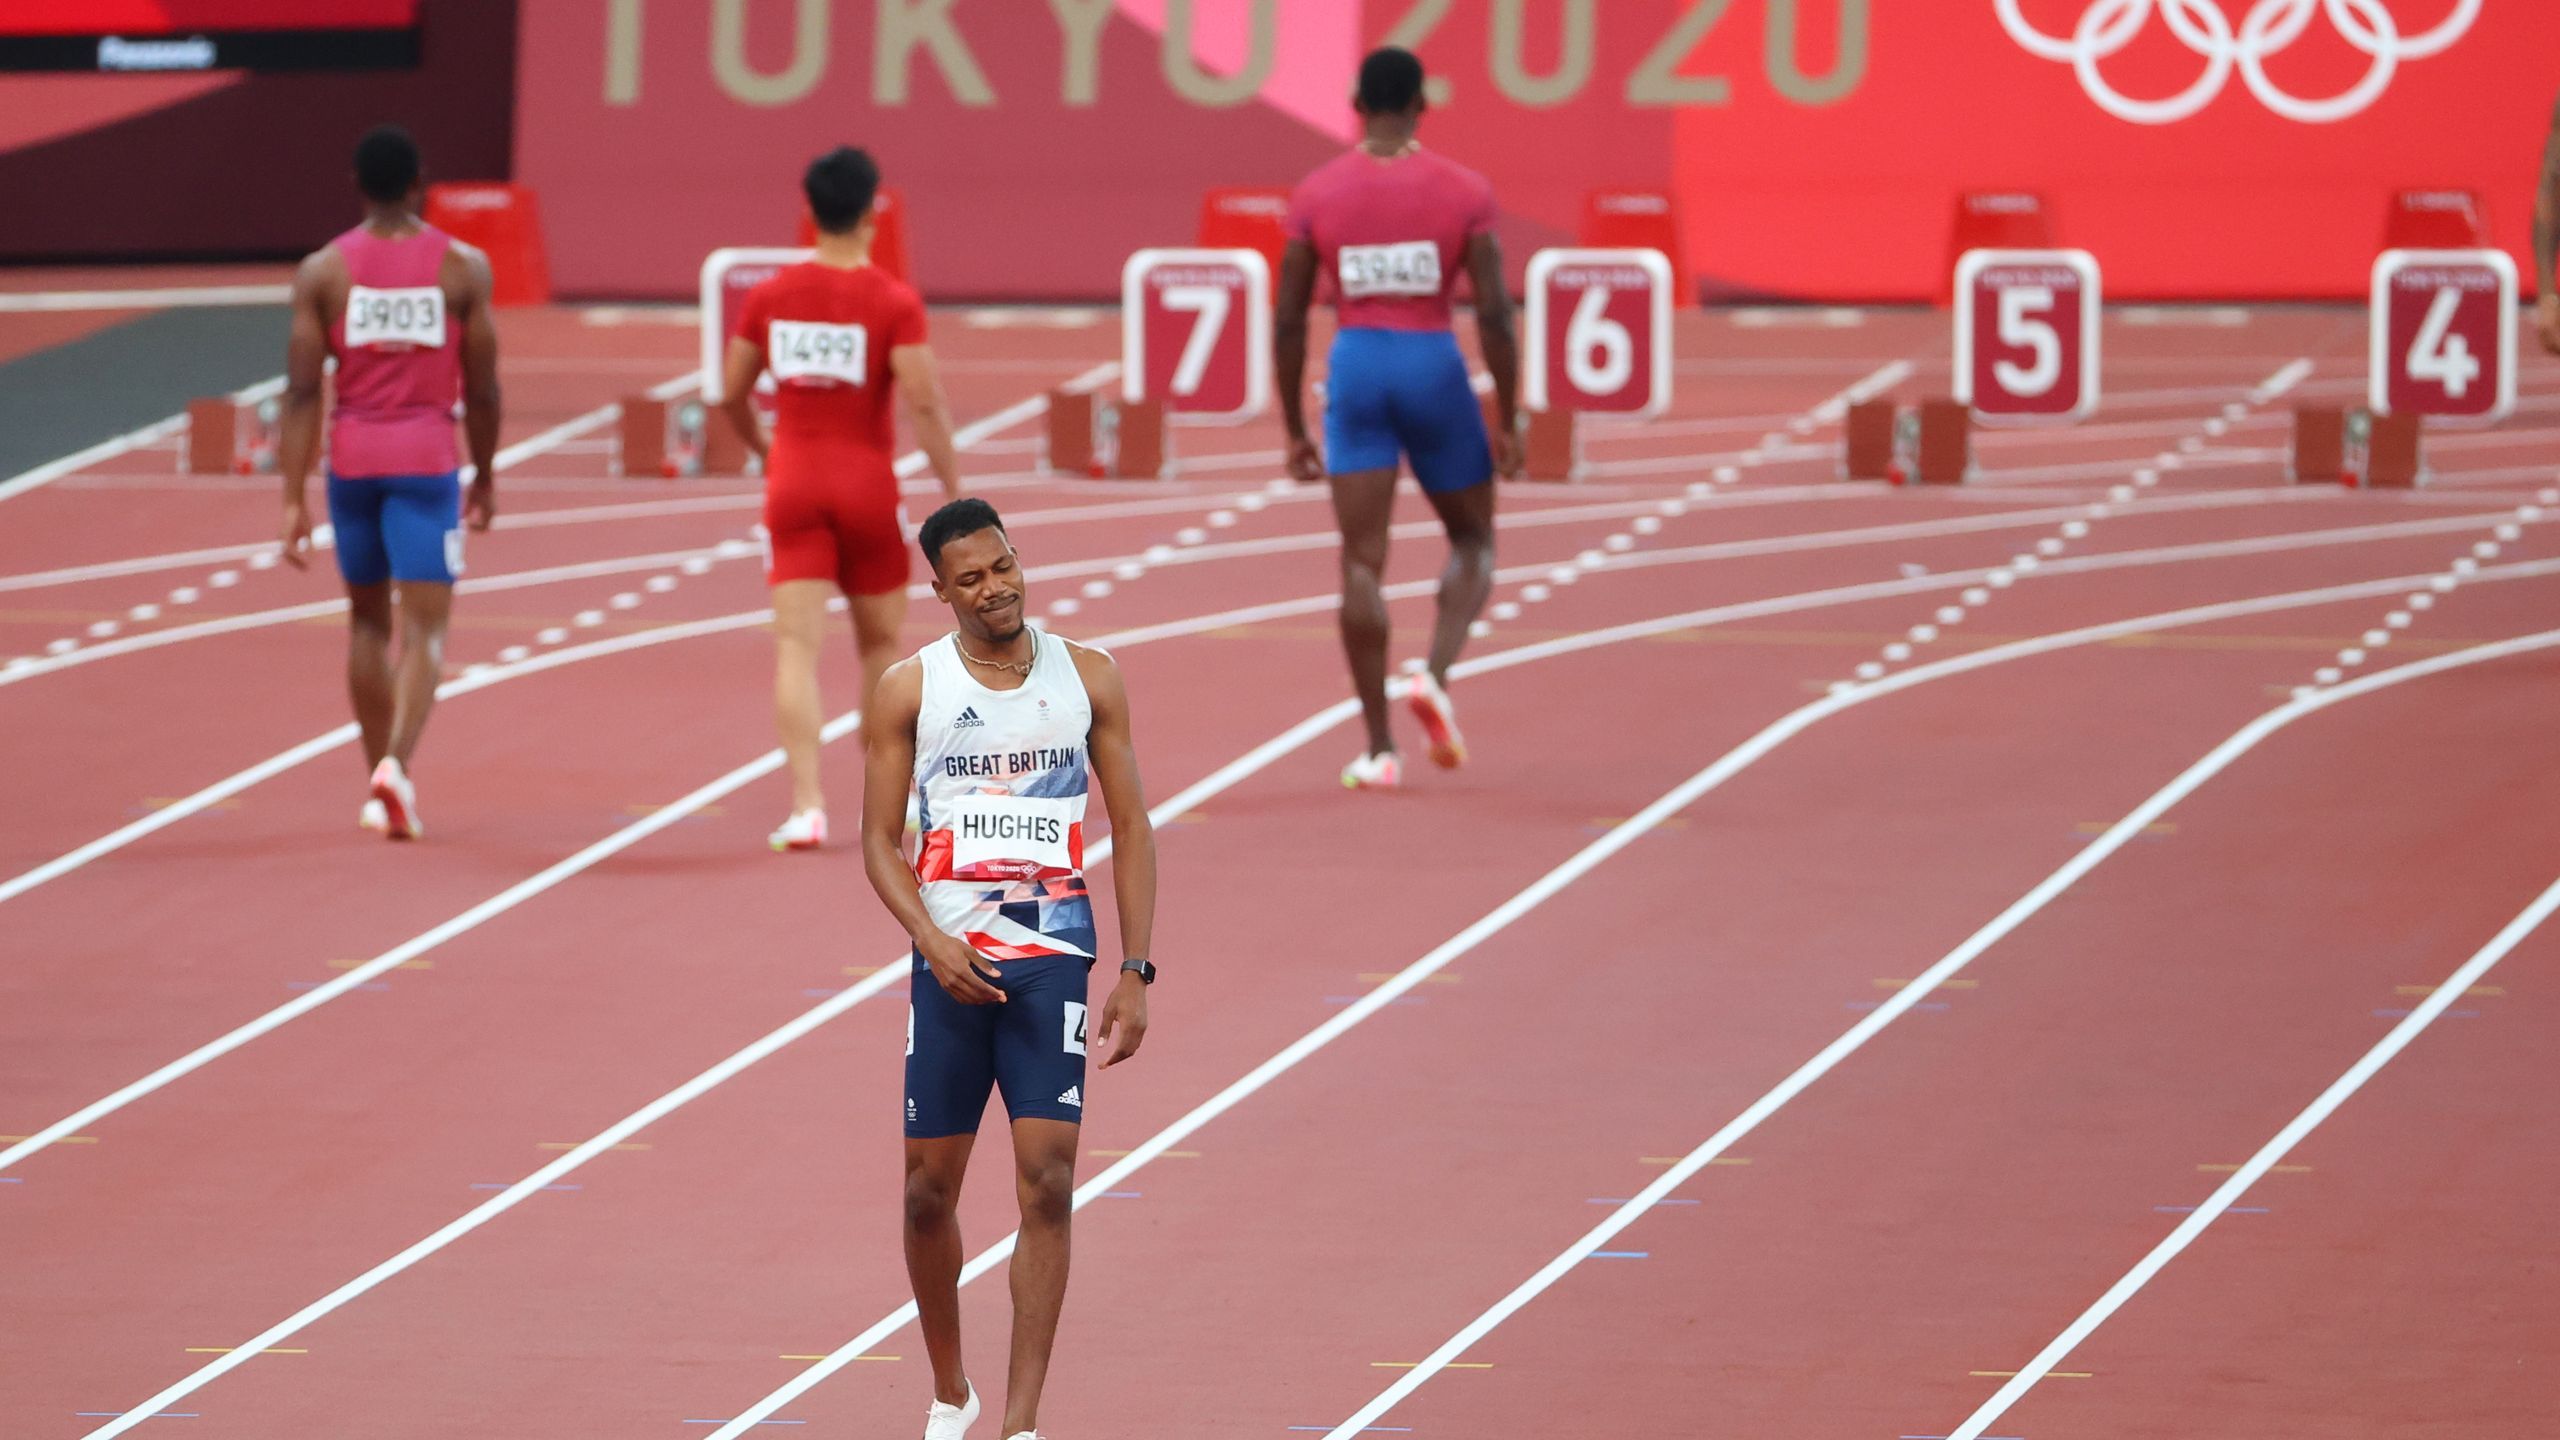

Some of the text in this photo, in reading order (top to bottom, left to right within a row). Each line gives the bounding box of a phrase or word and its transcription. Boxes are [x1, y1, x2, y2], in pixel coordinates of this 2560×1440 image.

[1348, 251, 1434, 286] 3940
[354, 297, 436, 331] 3903
[778, 330, 854, 365] 1499
[1160, 286, 1229, 395] 7
[1565, 286, 1633, 395] 6
[1992, 286, 2061, 397] 5
[2406, 286, 2480, 398] 4
[953, 719, 985, 729] adidas
[945, 747, 1074, 777] GREAT BRITAIN
[963, 814, 1060, 844] HUGHES
